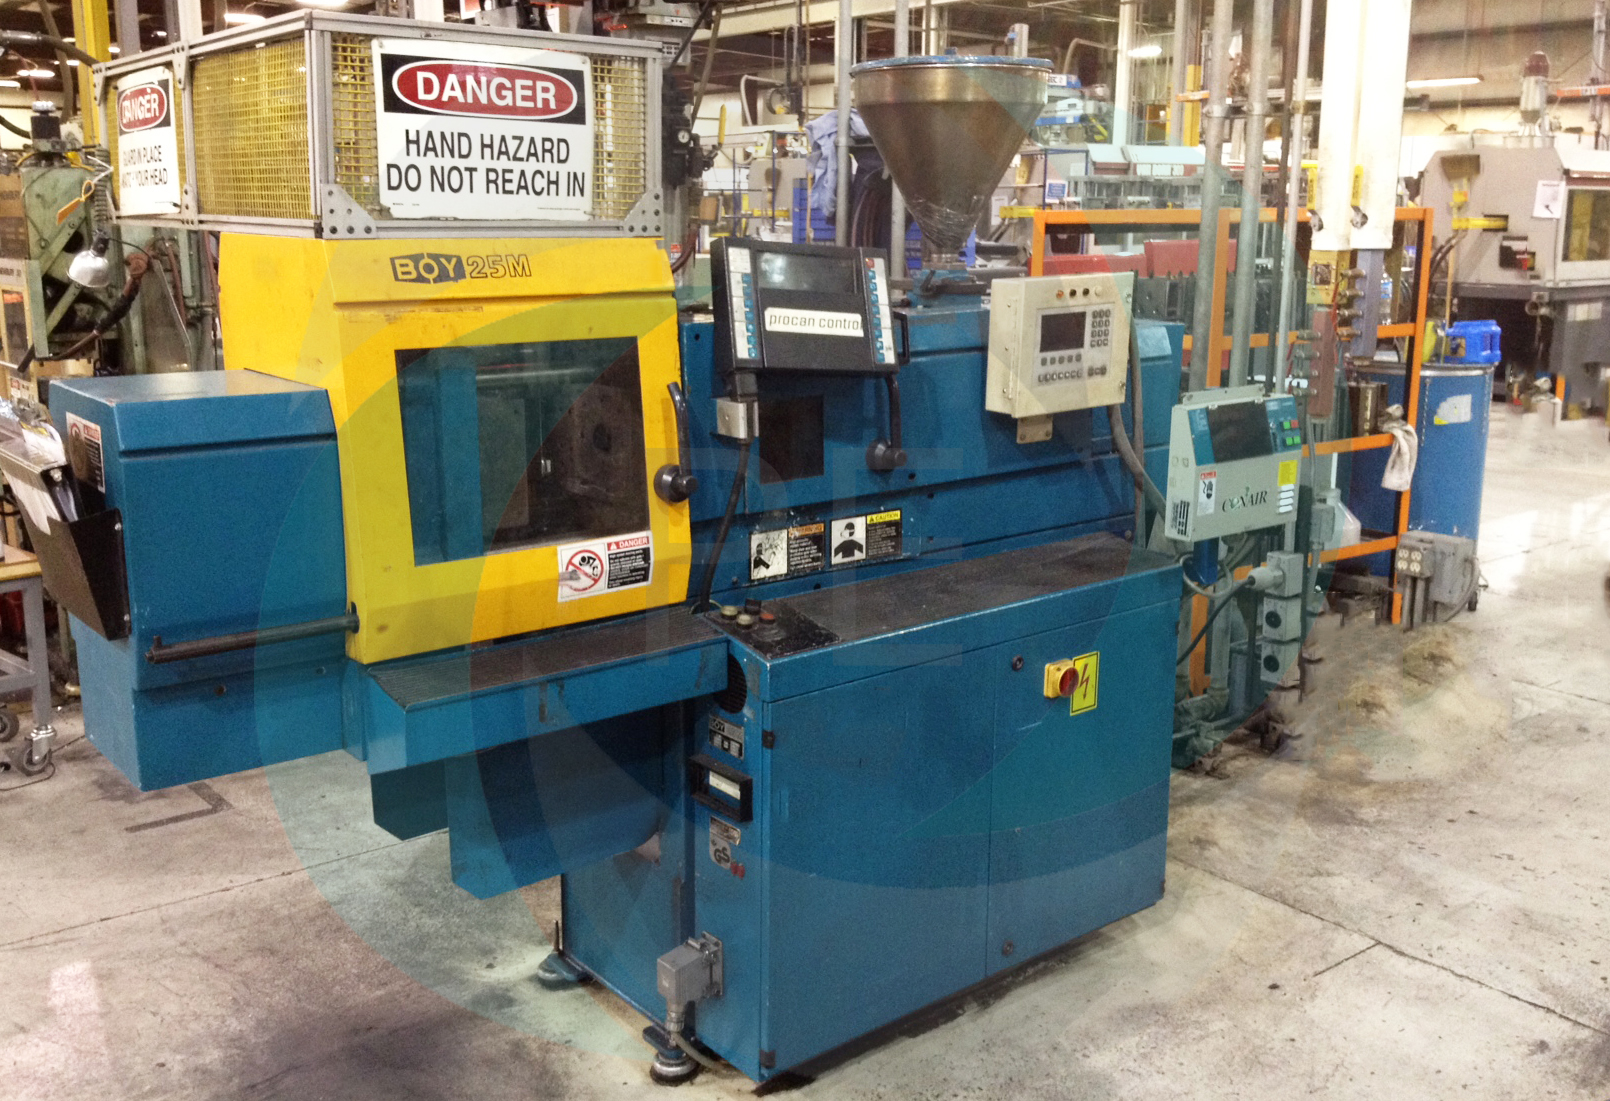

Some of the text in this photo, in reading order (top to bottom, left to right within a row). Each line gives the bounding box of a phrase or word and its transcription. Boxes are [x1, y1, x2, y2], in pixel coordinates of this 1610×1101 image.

[416, 71, 557, 110] DANGER
[122, 93, 160, 124] DANGER
[143, 145, 162, 164] PLACE
[405, 129, 570, 164] HAND HAZARD
[149, 167, 168, 187] HEAD
[386, 163, 586, 198] DO NOT REACH IN
[393, 254, 532, 281] BOY 25M
[769, 314, 816, 327] procan
[875, 512, 900, 521] CAUTION
[619, 536, 649, 549] DANGER
